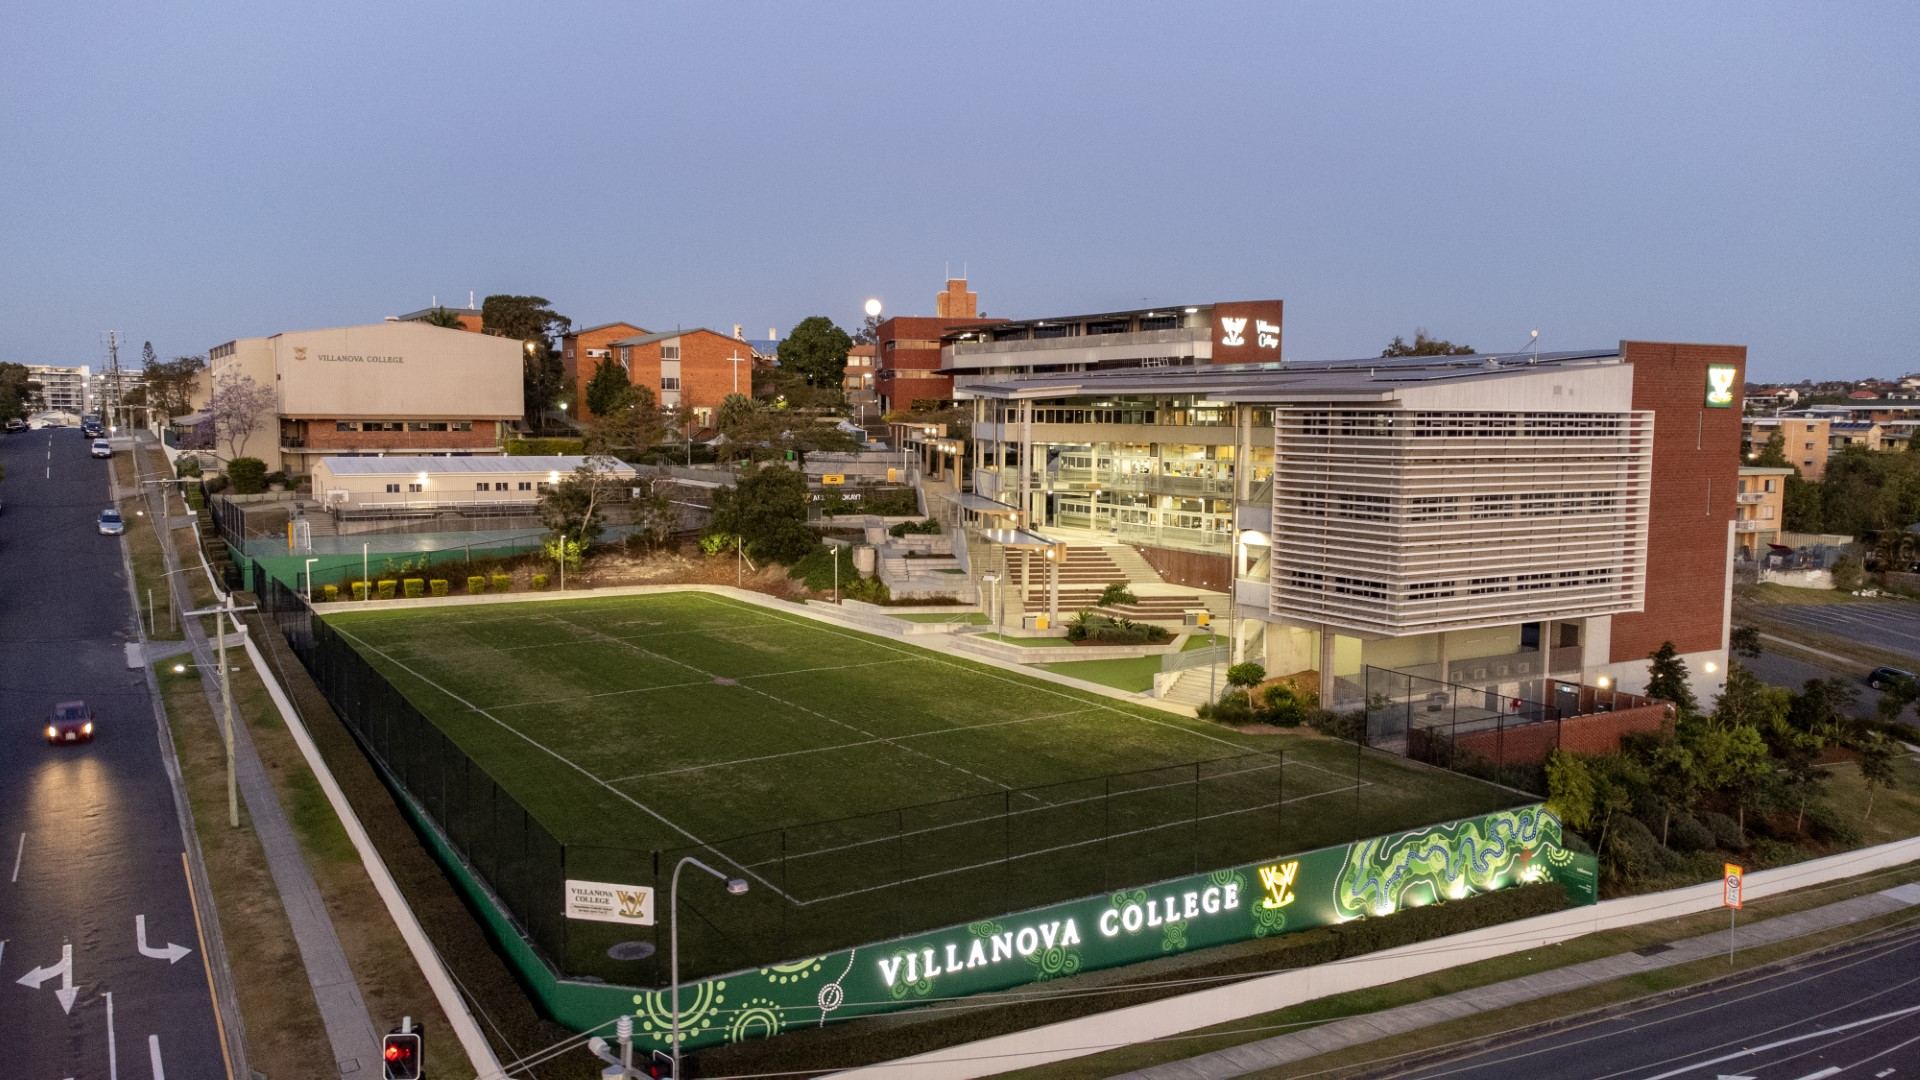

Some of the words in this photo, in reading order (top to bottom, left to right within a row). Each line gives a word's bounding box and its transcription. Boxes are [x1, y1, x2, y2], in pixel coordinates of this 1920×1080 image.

[318, 354, 364, 363] VILLANOVA
[366, 355, 404, 364] COLLEGE
[571, 887, 613, 898] VILLANOVA
[575, 895, 611, 905] COLLEGE
[878, 917, 1081, 987] VILLANOVA
[1099, 884, 1239, 937] COLLEGE
